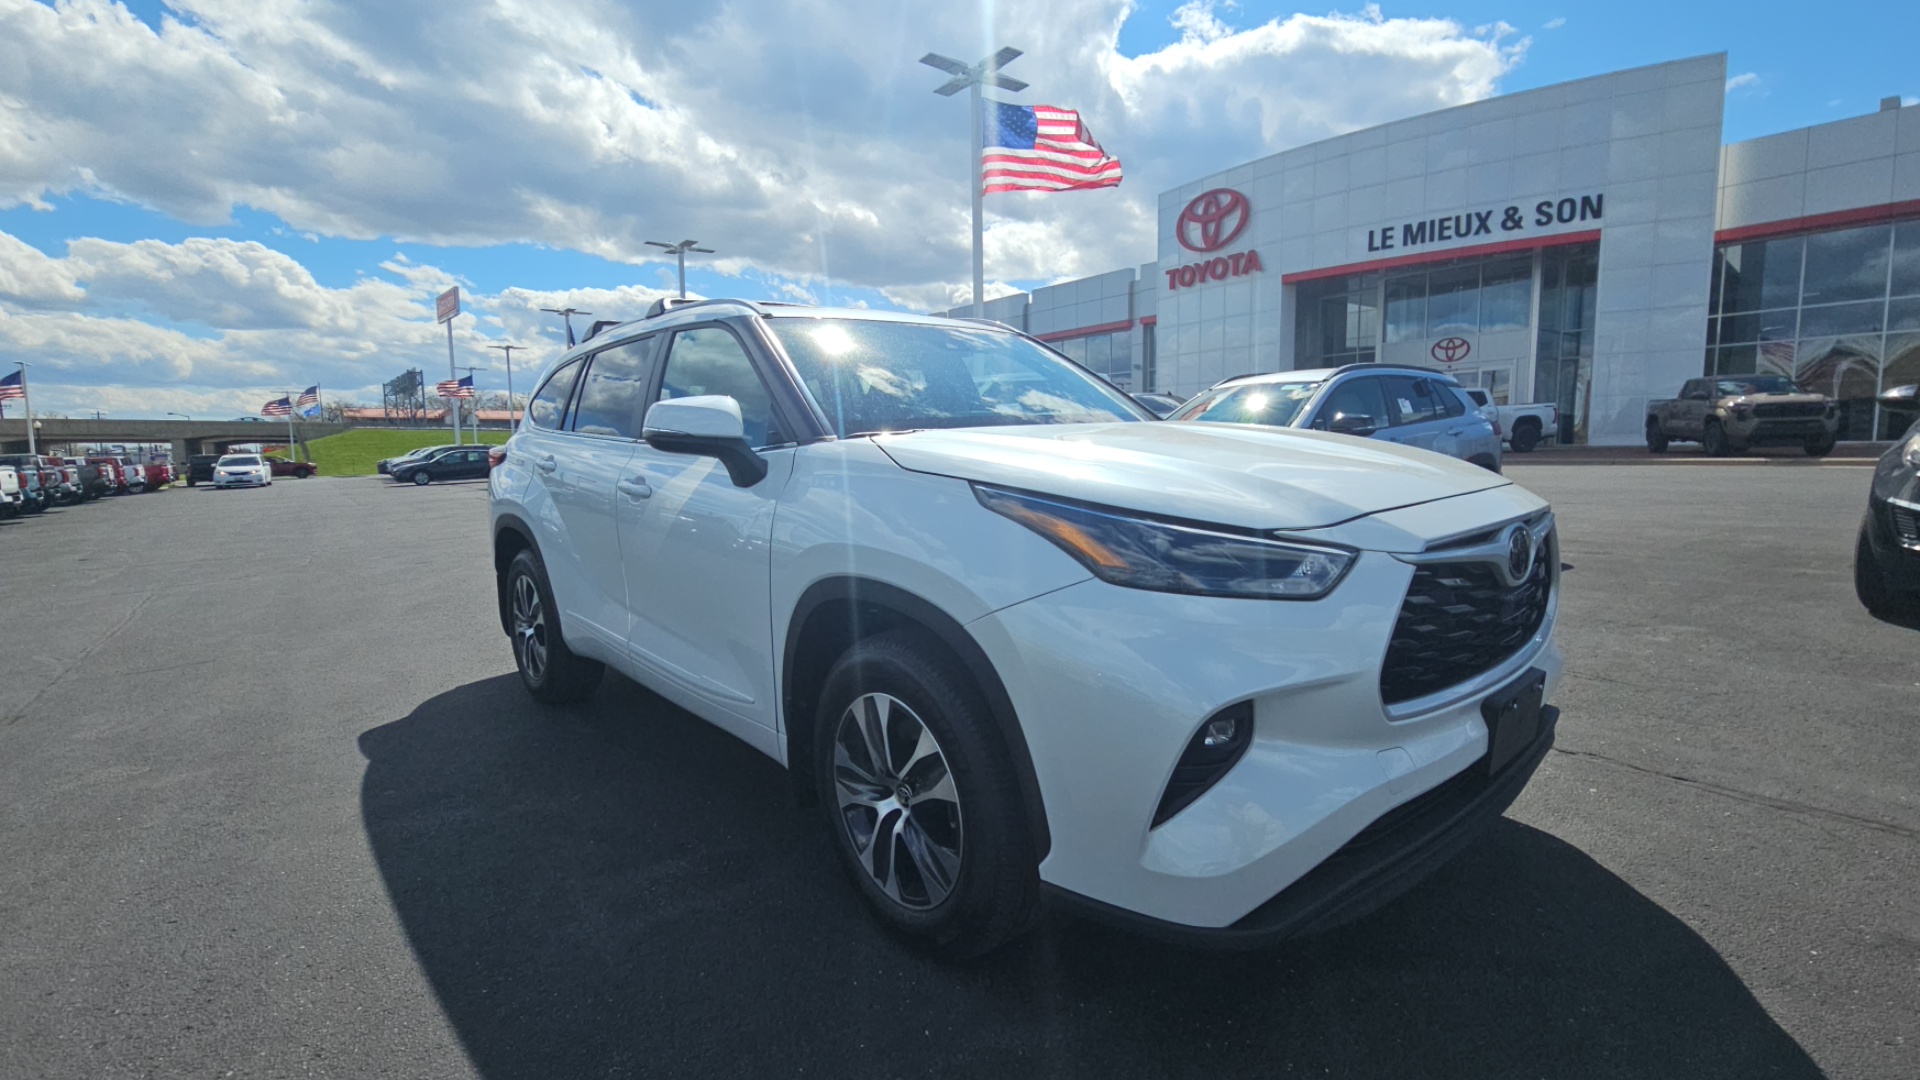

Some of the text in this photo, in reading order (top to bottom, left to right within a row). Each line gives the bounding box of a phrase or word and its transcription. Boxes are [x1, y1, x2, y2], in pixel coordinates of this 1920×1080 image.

[1367, 193, 1604, 252] LE MIEUX & SON
[1165, 249, 1263, 290] TOYOTA
